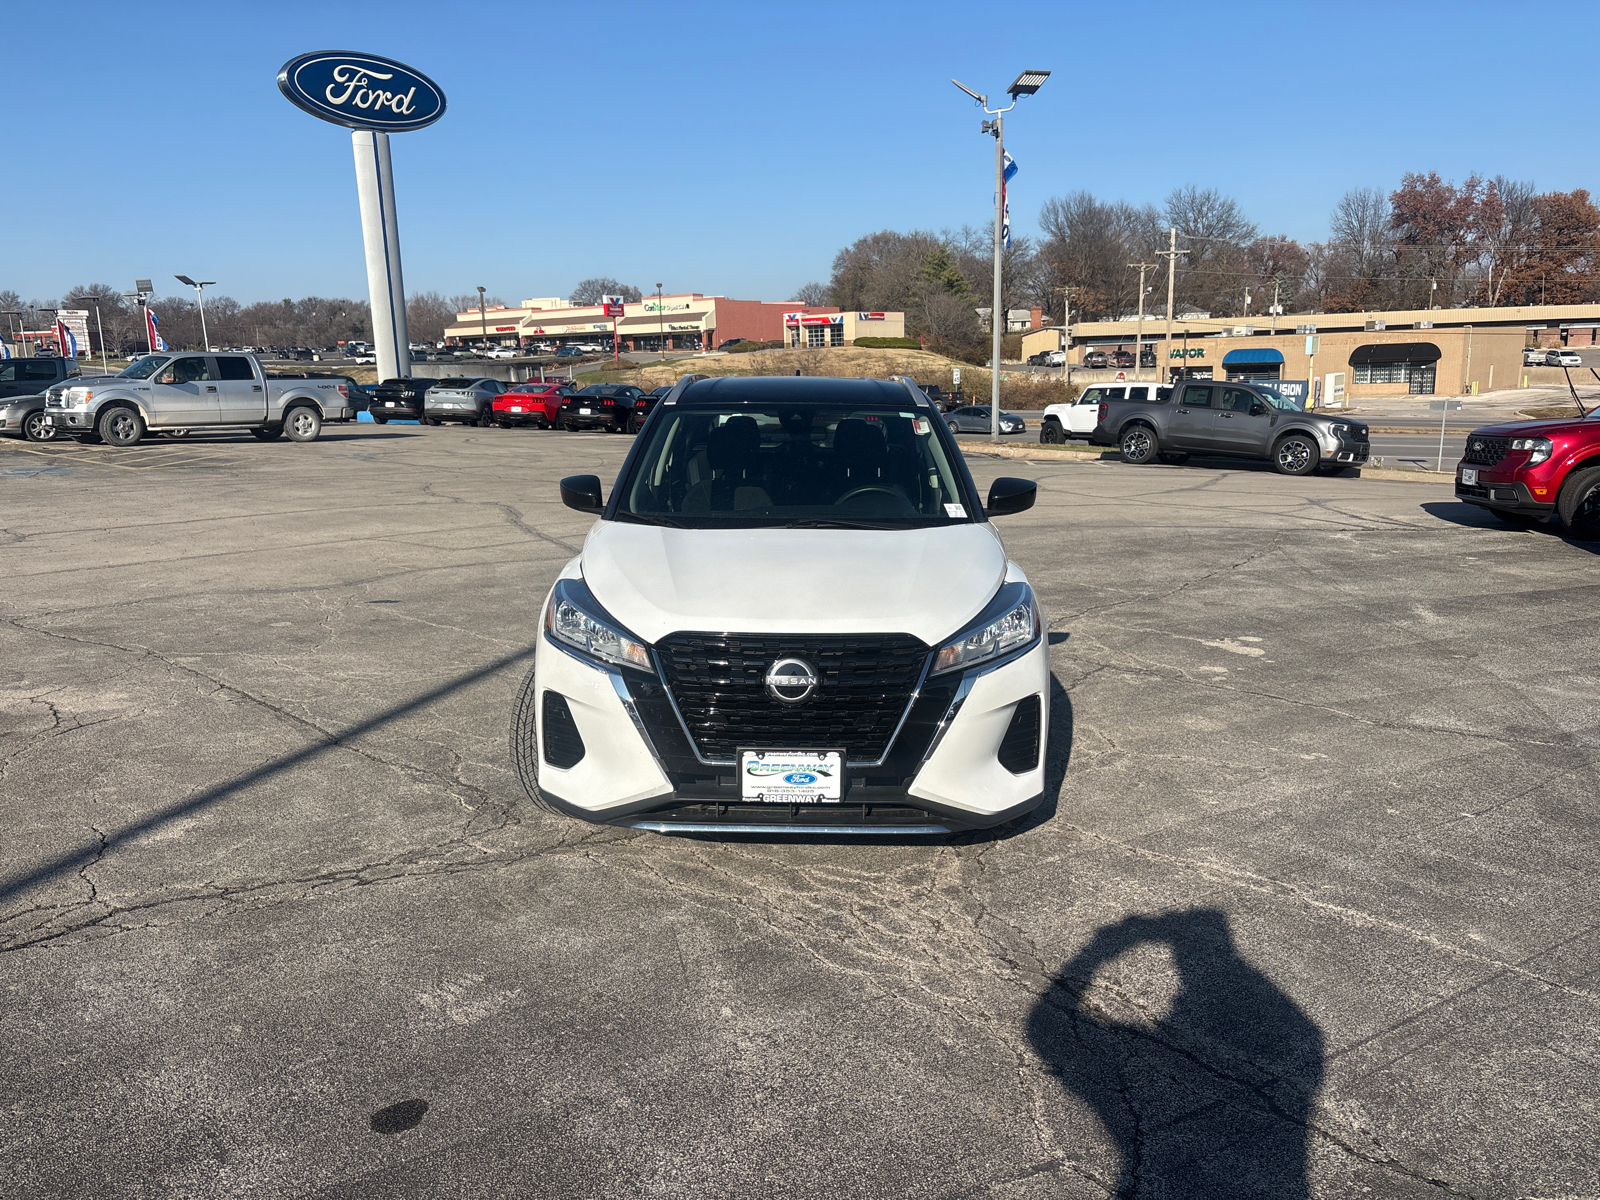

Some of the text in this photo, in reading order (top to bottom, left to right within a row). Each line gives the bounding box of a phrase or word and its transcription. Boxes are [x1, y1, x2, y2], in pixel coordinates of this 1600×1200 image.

[325, 64, 417, 116] Ford
[1170, 348, 1205, 359] VAPOR
[767, 677, 817, 685] NISSAN
[746, 760, 835, 772] GREENWAY
[790, 774, 811, 783] Ford
[763, 794, 819, 803] GREENWAY
